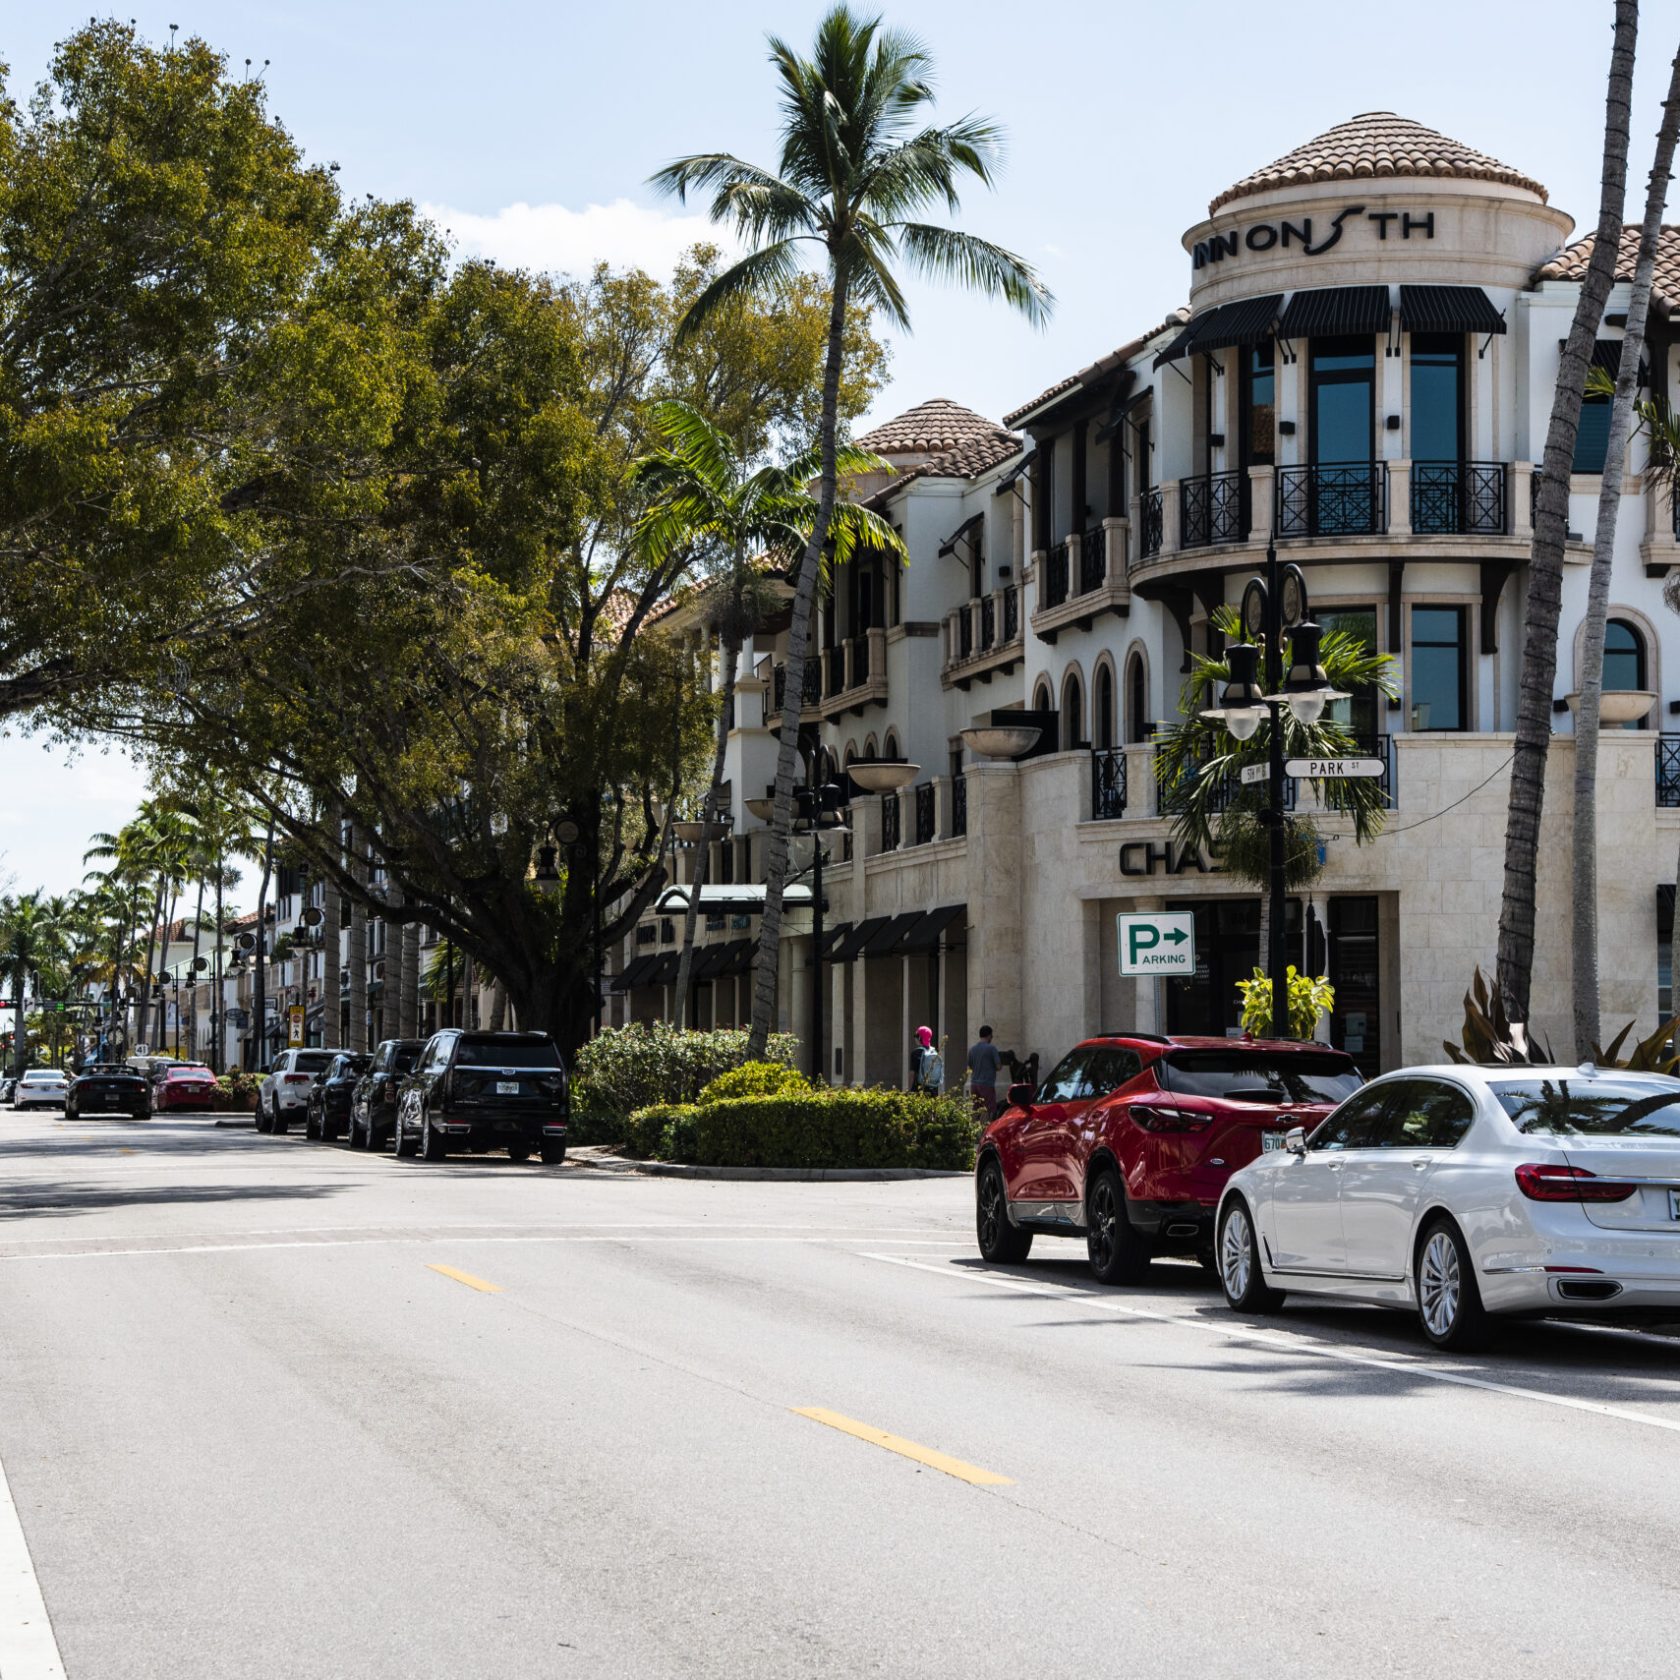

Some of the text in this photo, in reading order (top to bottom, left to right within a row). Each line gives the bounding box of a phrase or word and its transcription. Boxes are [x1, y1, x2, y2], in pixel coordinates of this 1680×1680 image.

[1193, 206, 1434, 270] INN ON 5TH
[1310, 761, 1360, 775] PARK ST
[1120, 840, 1233, 876] CHAS
